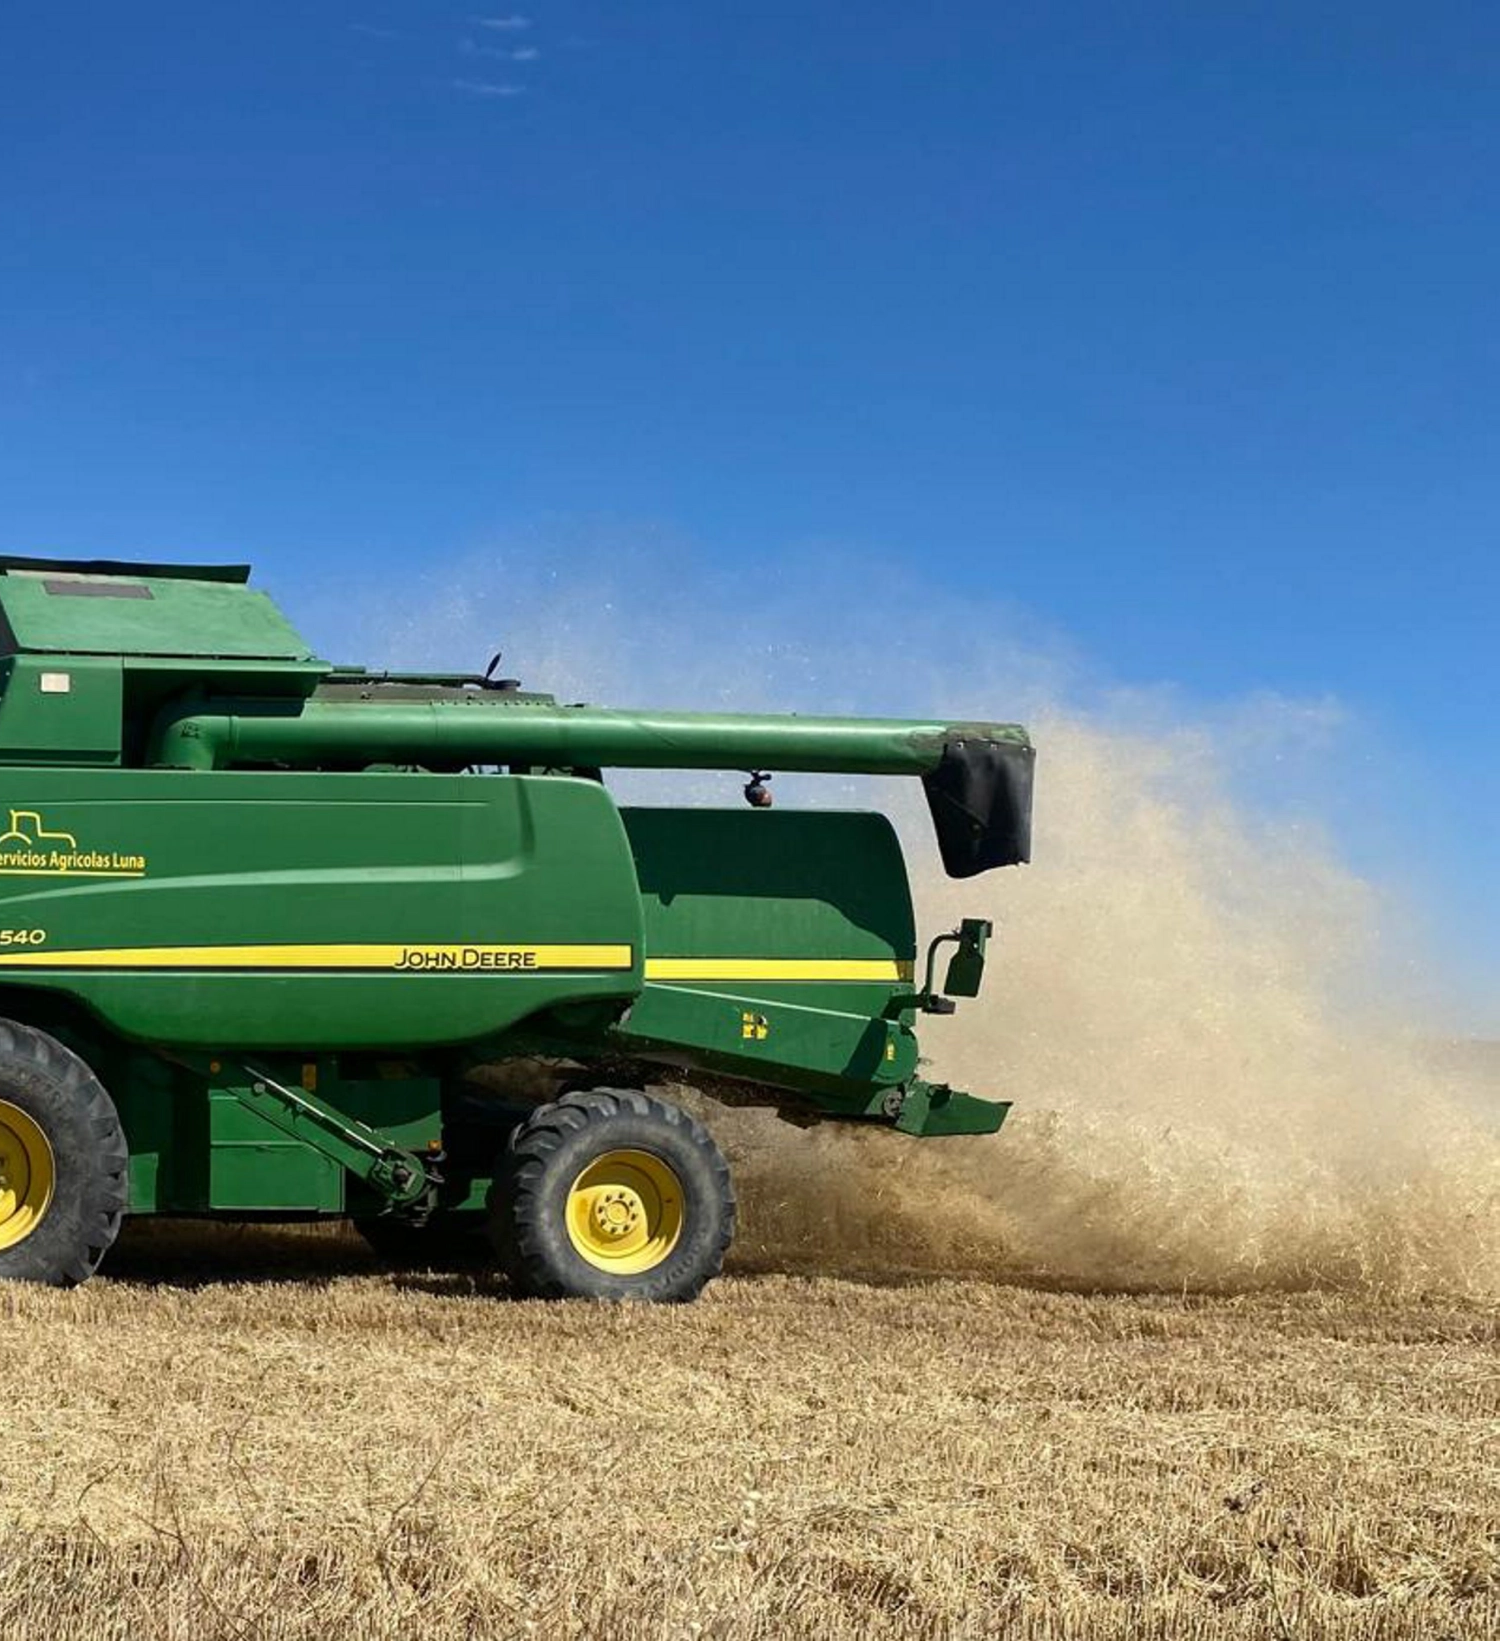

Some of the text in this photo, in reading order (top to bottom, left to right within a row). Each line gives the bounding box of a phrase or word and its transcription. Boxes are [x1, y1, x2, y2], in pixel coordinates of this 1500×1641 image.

[112, 852, 146, 869] Luna
[395, 948, 537, 968] JOHN DEERE
